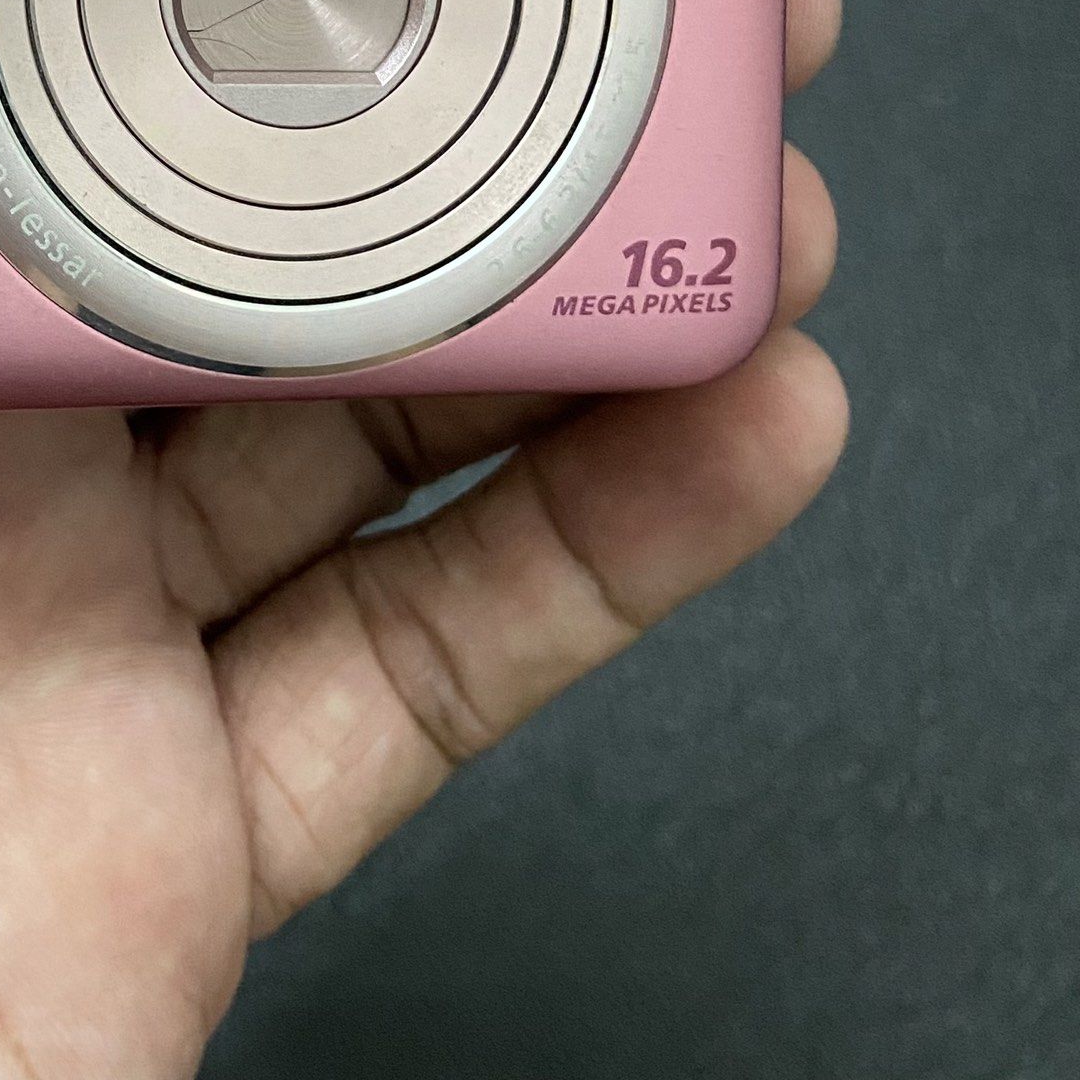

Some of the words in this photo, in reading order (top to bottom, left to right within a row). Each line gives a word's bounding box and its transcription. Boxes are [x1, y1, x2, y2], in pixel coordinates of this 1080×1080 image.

[621, 237, 737, 288] 16.2
[551, 294, 636, 317] MEGA
[642, 291, 734, 314] PIXELS
